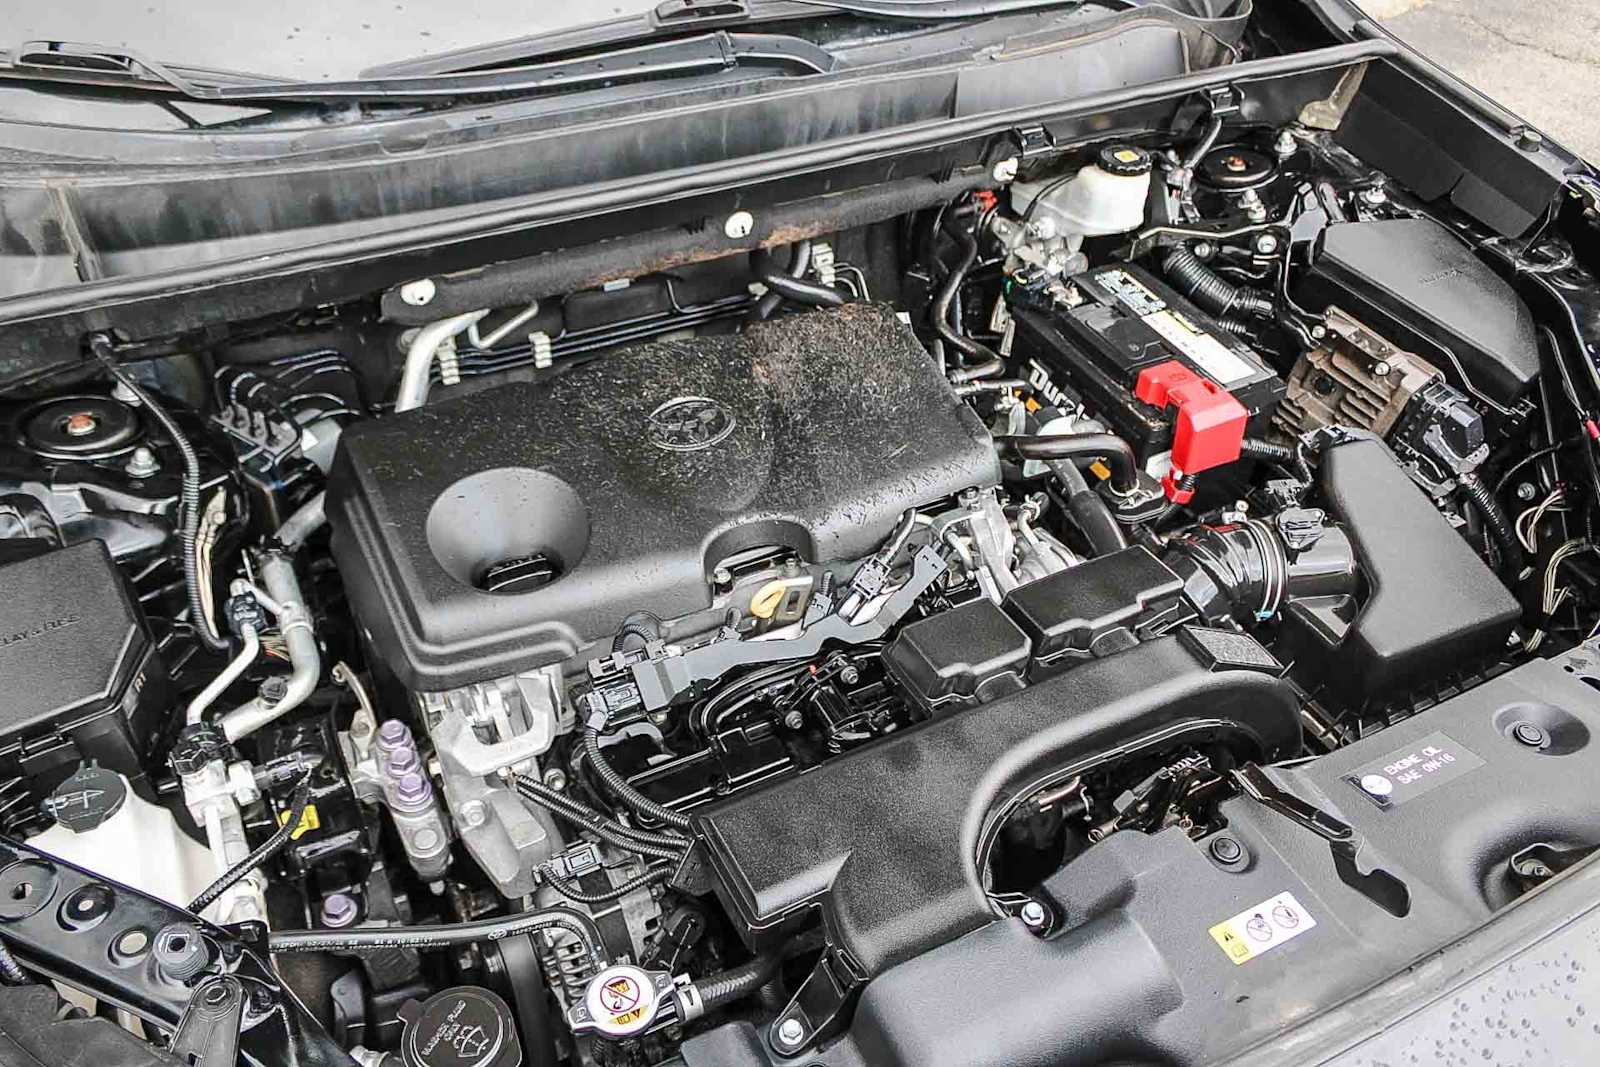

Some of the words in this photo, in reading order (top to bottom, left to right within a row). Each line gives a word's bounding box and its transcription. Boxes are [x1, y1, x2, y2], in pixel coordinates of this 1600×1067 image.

[1384, 754, 1422, 775] ENGINE
[1422, 746, 1442, 757] OIL
[1397, 769, 1422, 784] SAE
